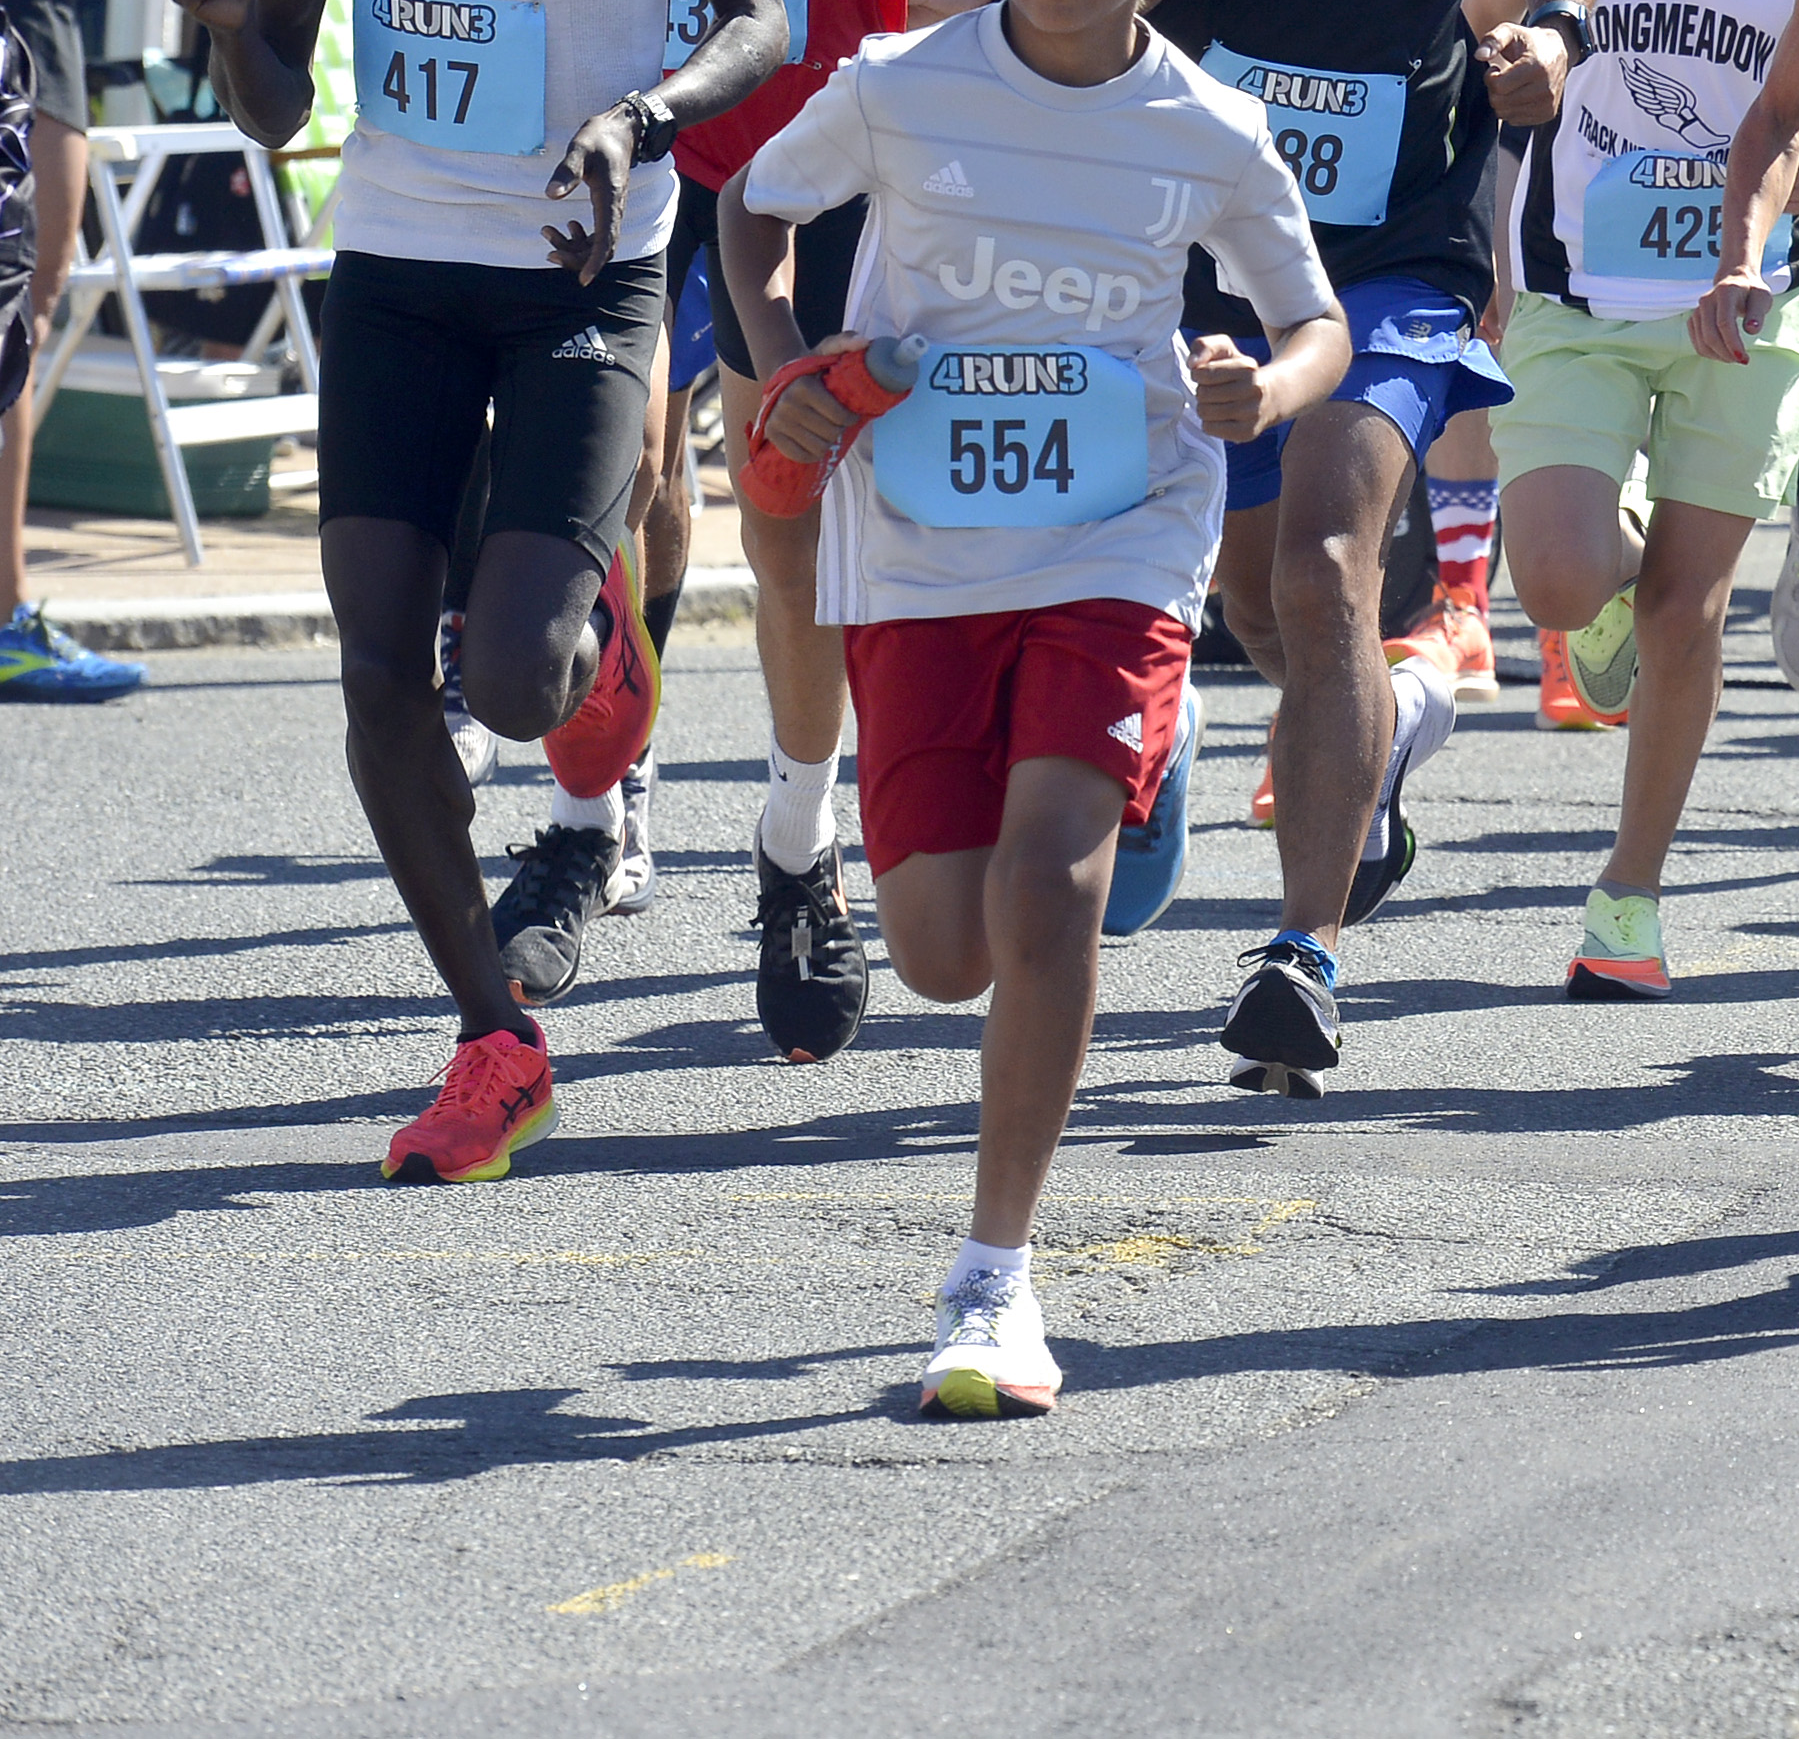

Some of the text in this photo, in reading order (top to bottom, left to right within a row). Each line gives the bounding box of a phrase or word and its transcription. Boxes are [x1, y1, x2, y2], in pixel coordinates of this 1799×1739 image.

[1594, 3, 1776, 84] ONGMEADOW
[383, 50, 480, 125] 417
[1236, 65, 1369, 118] 4RUN3
[1577, 104, 1619, 158] TRACK
[1275, 128, 1344, 196] 88
[1630, 155, 1732, 189] 4RUN
[923, 181, 974, 199] adidas
[938, 235, 1142, 332] Jeep
[552, 346, 616, 366] adidas
[930, 352, 1088, 395] 4RUN3
[949, 419, 1075, 494] 554
[1107, 725, 1144, 754] adidas
